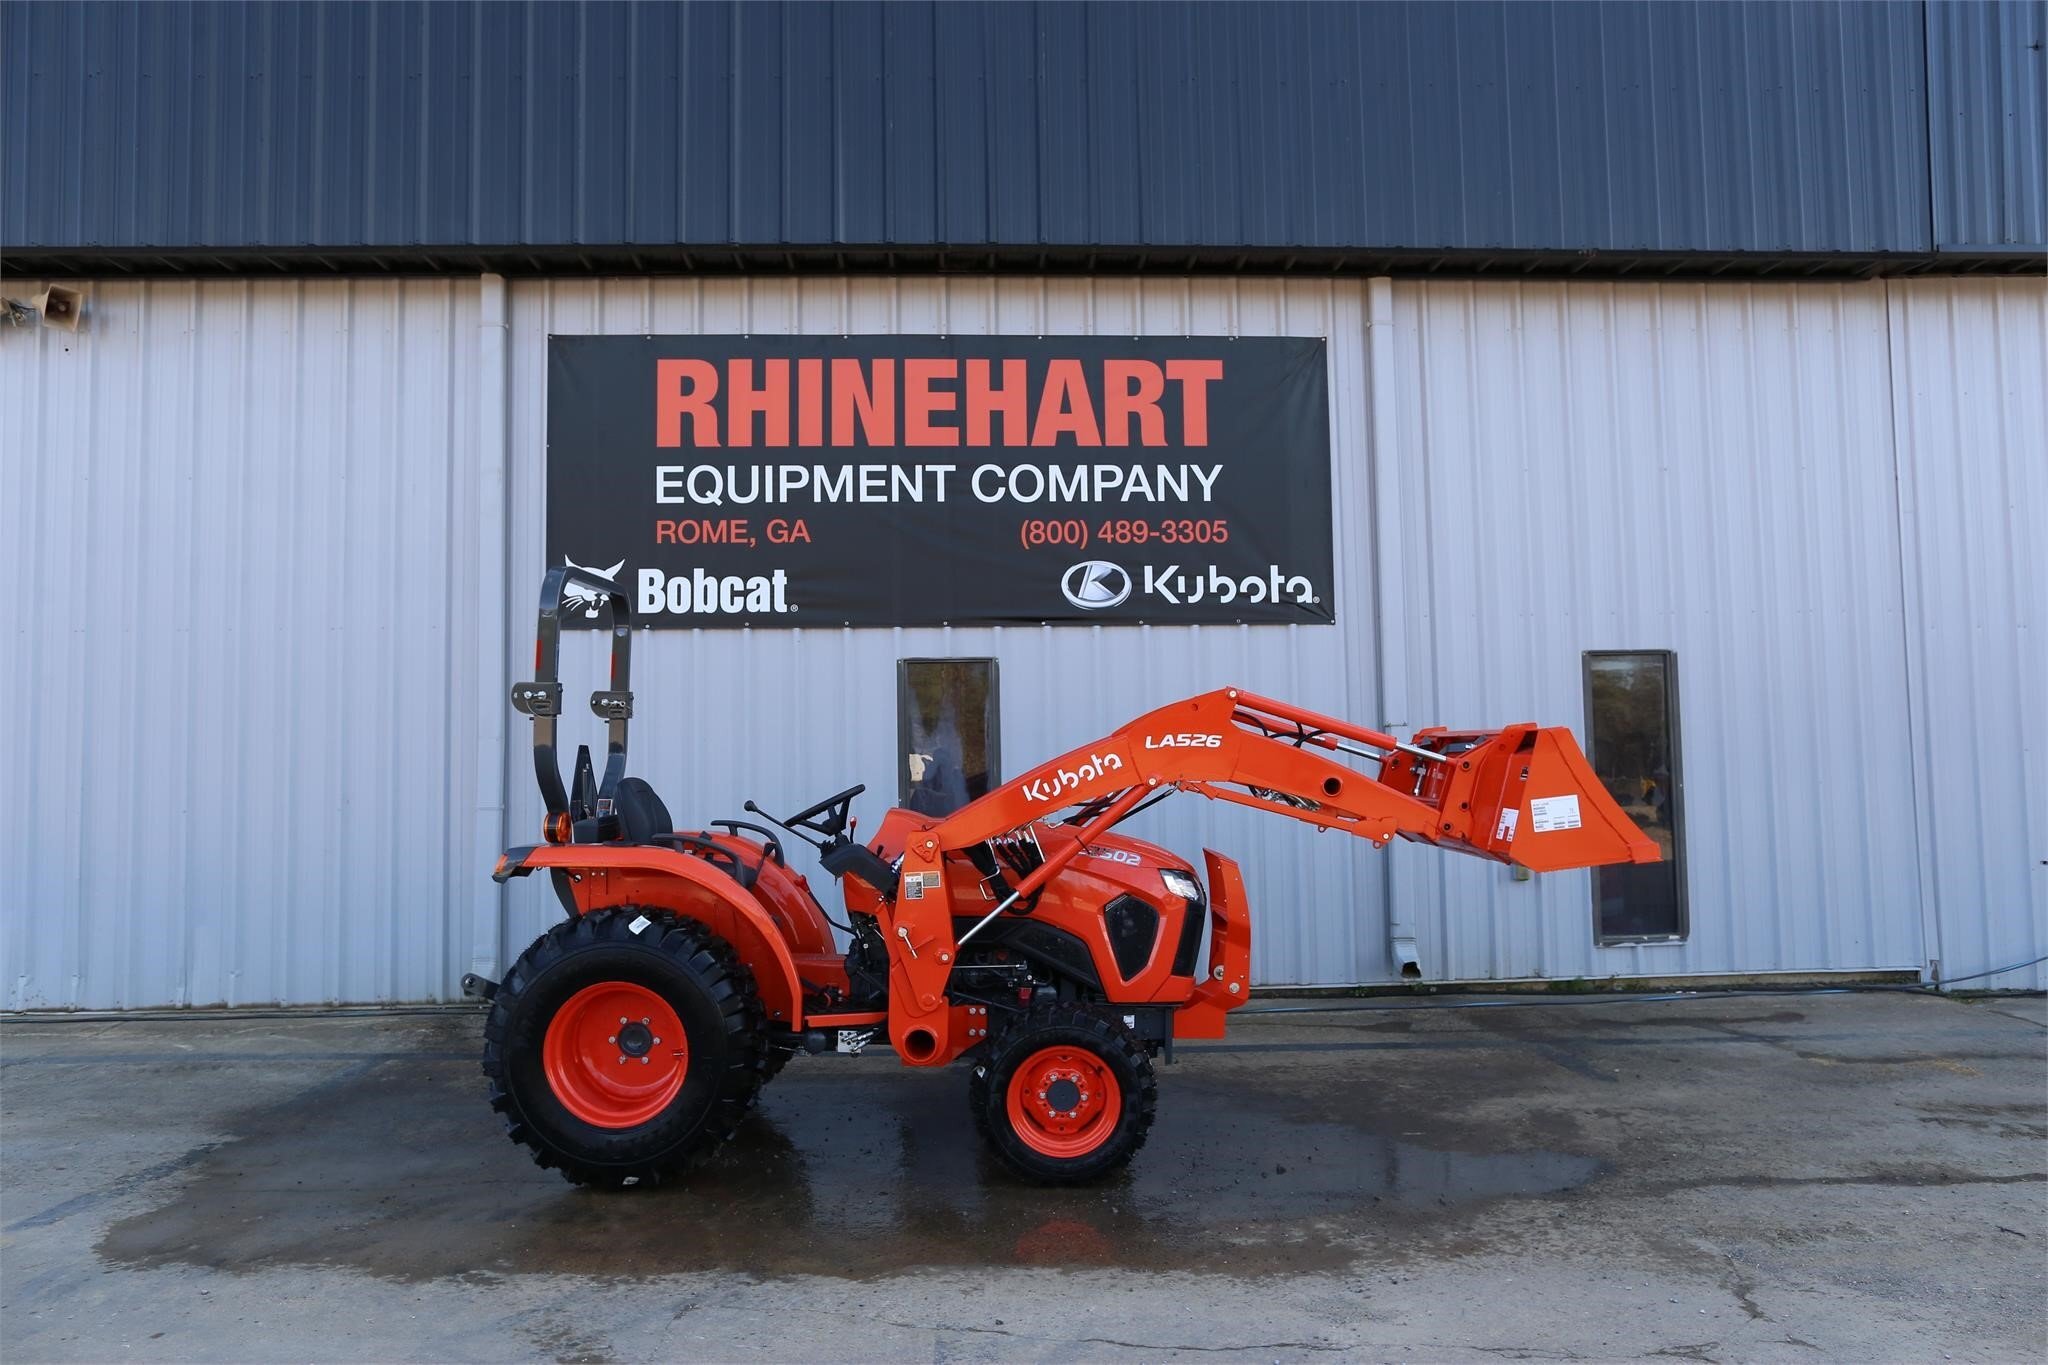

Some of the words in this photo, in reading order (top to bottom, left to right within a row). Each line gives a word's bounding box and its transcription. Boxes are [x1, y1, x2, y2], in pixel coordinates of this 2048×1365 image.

[656, 358, 1223, 447] RHINEHART
[655, 464, 957, 506] EQUIPMENT
[971, 463, 1224, 503] COMPANY
[656, 519, 756, 547] ROME,
[766, 519, 811, 544] GA
[1020, 519, 1089, 549] (800)
[1098, 520, 1228, 544] 489-3305
[1145, 733, 1223, 749] LA526
[1022, 752, 1123, 802] Kubota
